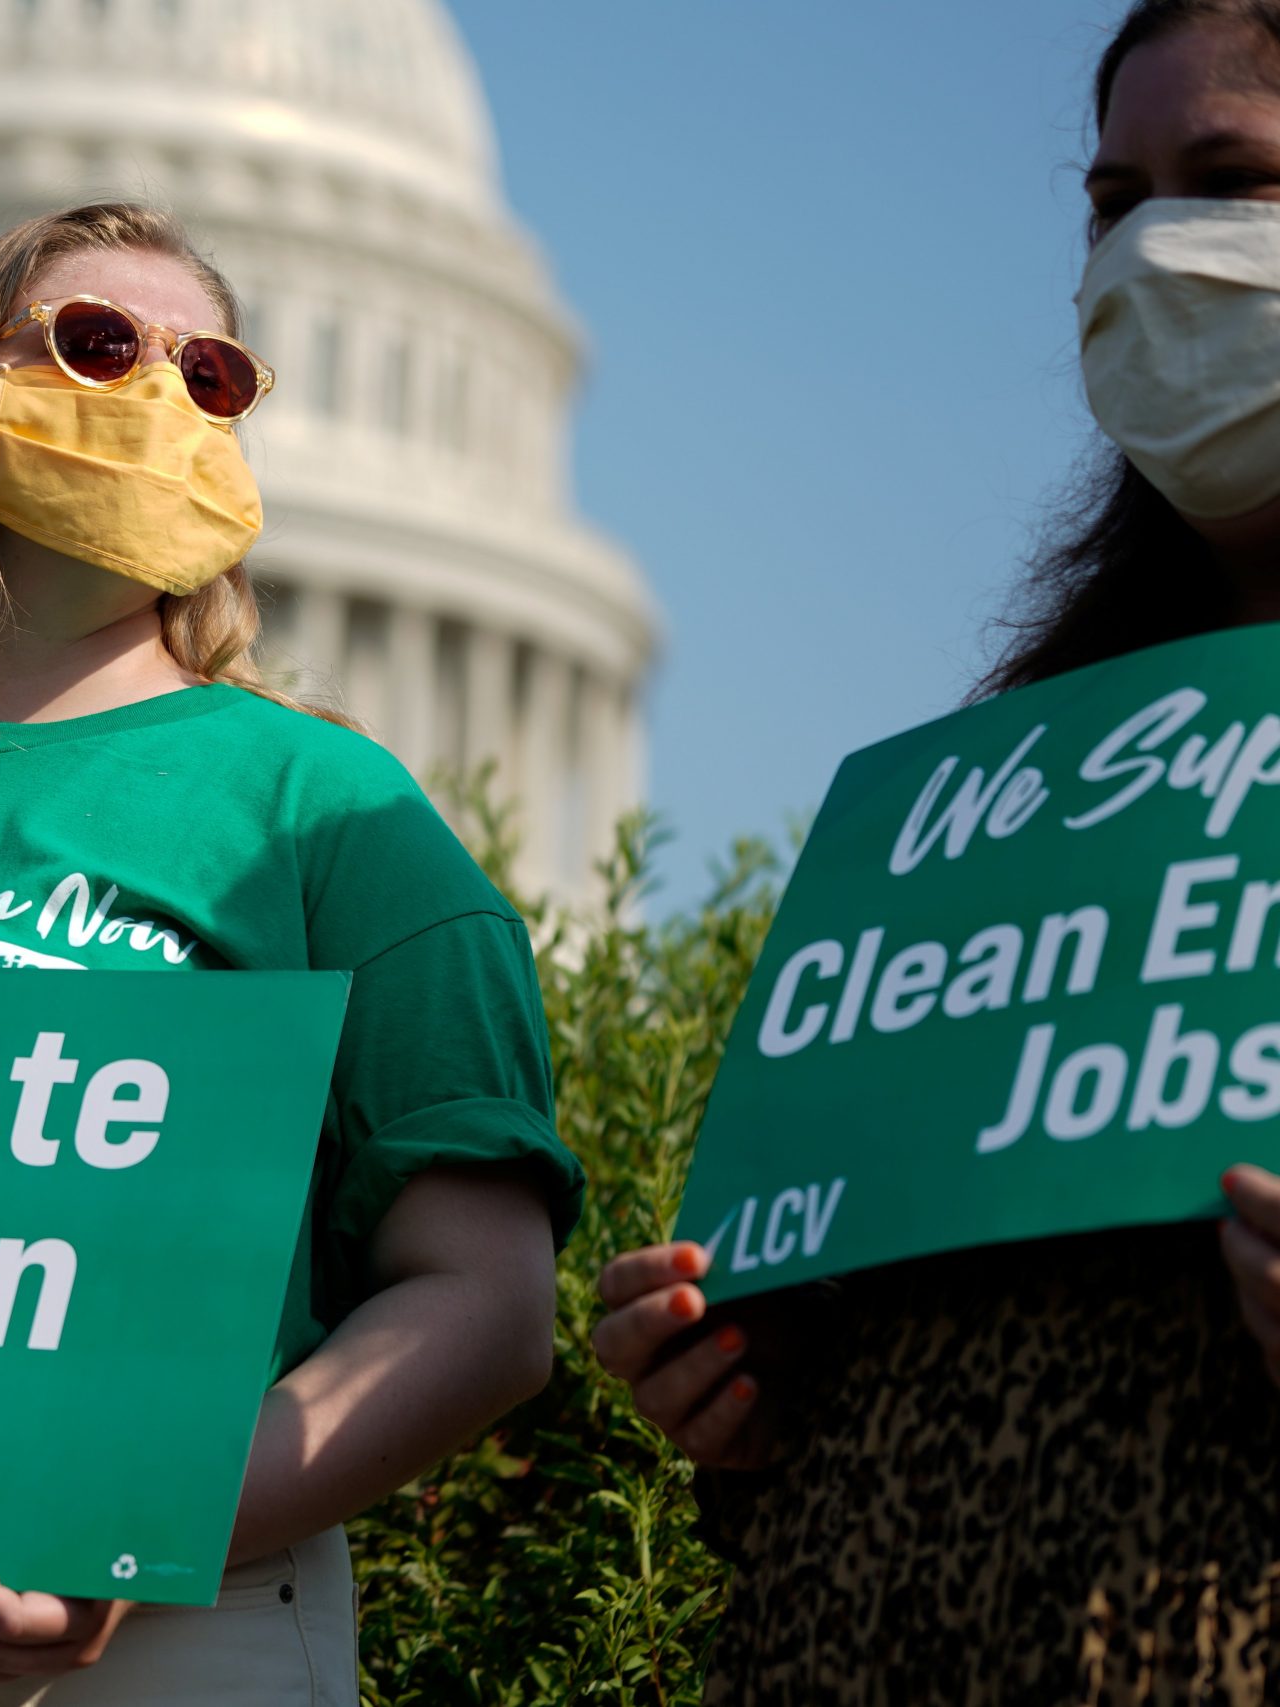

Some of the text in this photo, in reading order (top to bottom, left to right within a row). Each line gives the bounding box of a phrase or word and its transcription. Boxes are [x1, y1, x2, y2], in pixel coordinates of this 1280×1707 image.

[888, 723, 1050, 876] We
[36, 872, 199, 965] Now
[757, 904, 1110, 1058] Clean
[975, 1003, 1280, 1154] Jobs
[730, 1180, 846, 1273] LCV
